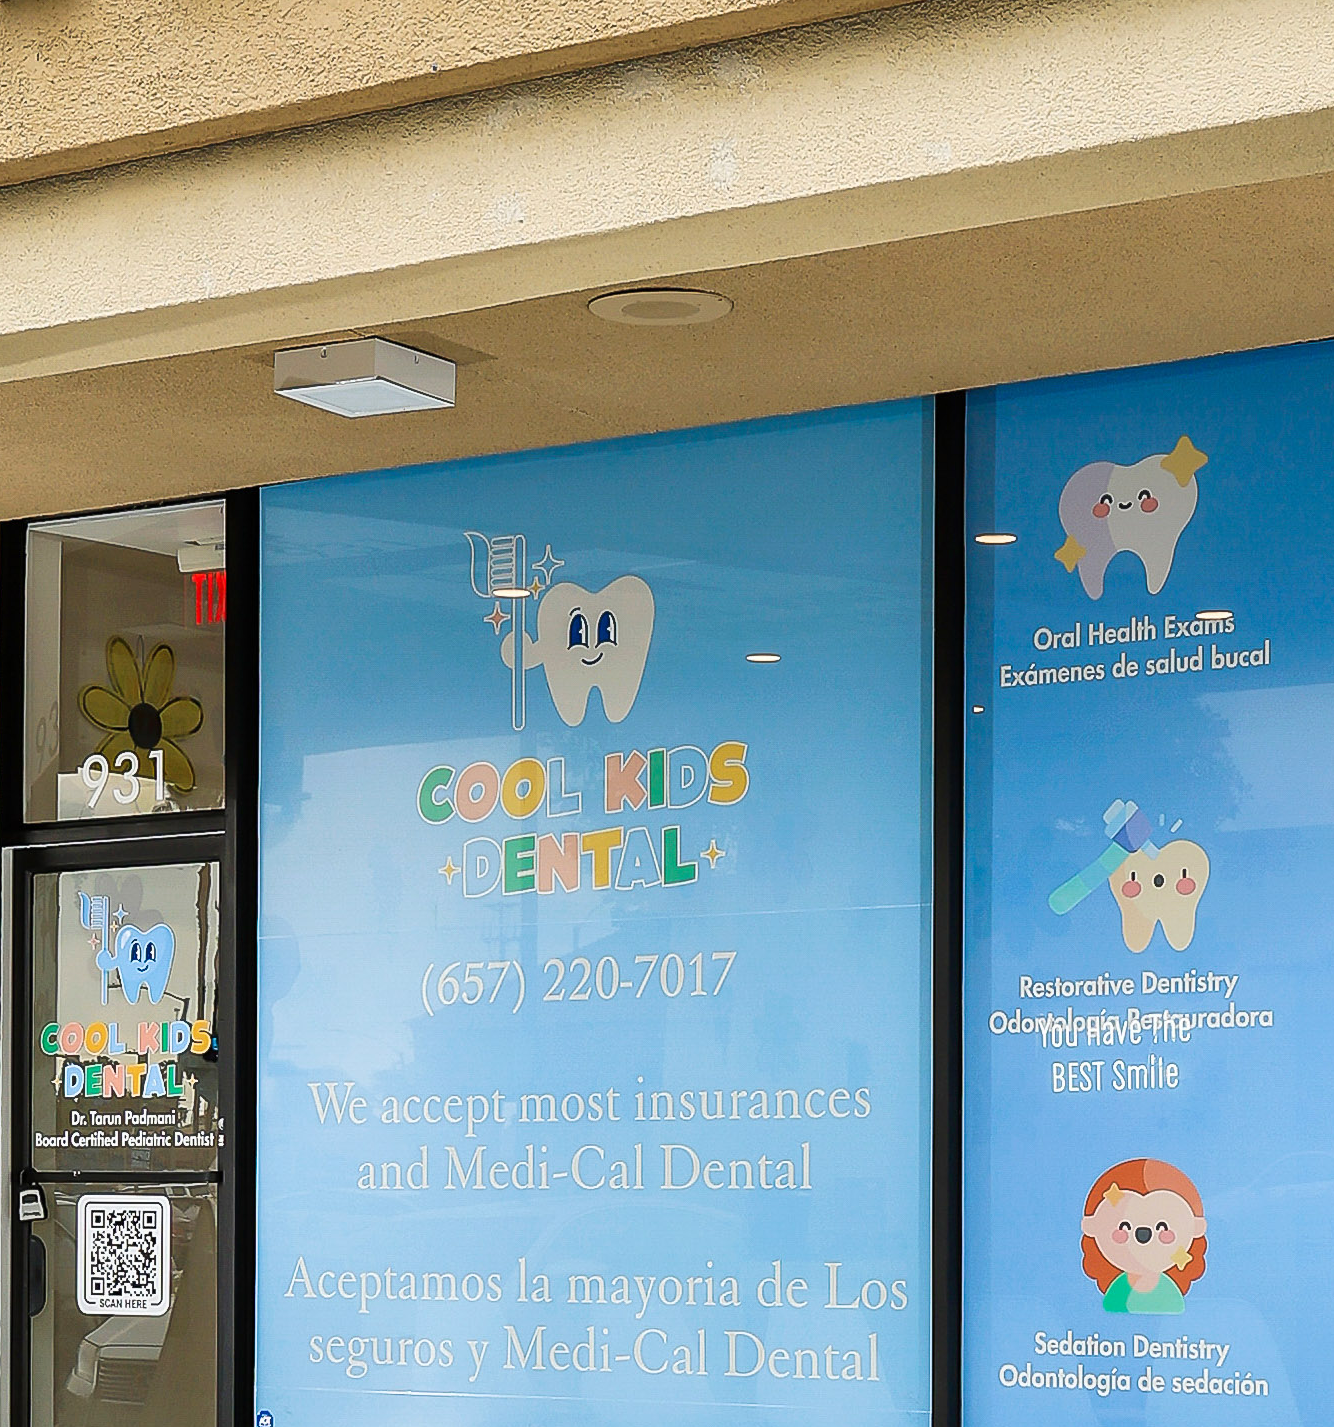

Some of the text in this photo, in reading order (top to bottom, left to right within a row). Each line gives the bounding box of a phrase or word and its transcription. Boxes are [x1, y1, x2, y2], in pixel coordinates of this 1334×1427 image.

[1033, 615, 1235, 650] Oral Health Exams
[1000, 639, 1270, 687] Exámenes de salud bucal
[82, 749, 164, 808] 931
[417, 740, 750, 825] COOL KIDS
[463, 825, 699, 899] DENTAL
[420, 950, 738, 1017] (657) 220-7017
[1019, 969, 1239, 999] Restorative Dentistry
[40, 1019, 211, 1056] COOL KIDS
[64, 1063, 184, 1098] DENTAL
[1052, 1053, 1179, 1093] BEST Smile
[71, 1109, 176, 1127] Dr. Tarun Padmani
[307, 1076, 873, 1138] We accept most insurances
[35, 1131, 215, 1147] Board Certified Pediatric Dentist
[357, 1141, 813, 1192] and Medi-Cal Dental
[99, 1299, 147, 1309] SCAN HERE
[283, 1255, 909, 1319] Aceptamos la mayoria de Los
[307, 1325, 881, 1383] seguros y Medi-Cal Dental
[1034, 1329, 1230, 1367] Sedation Dentistry
[998, 1363, 1269, 1398] Odontología de sedación
